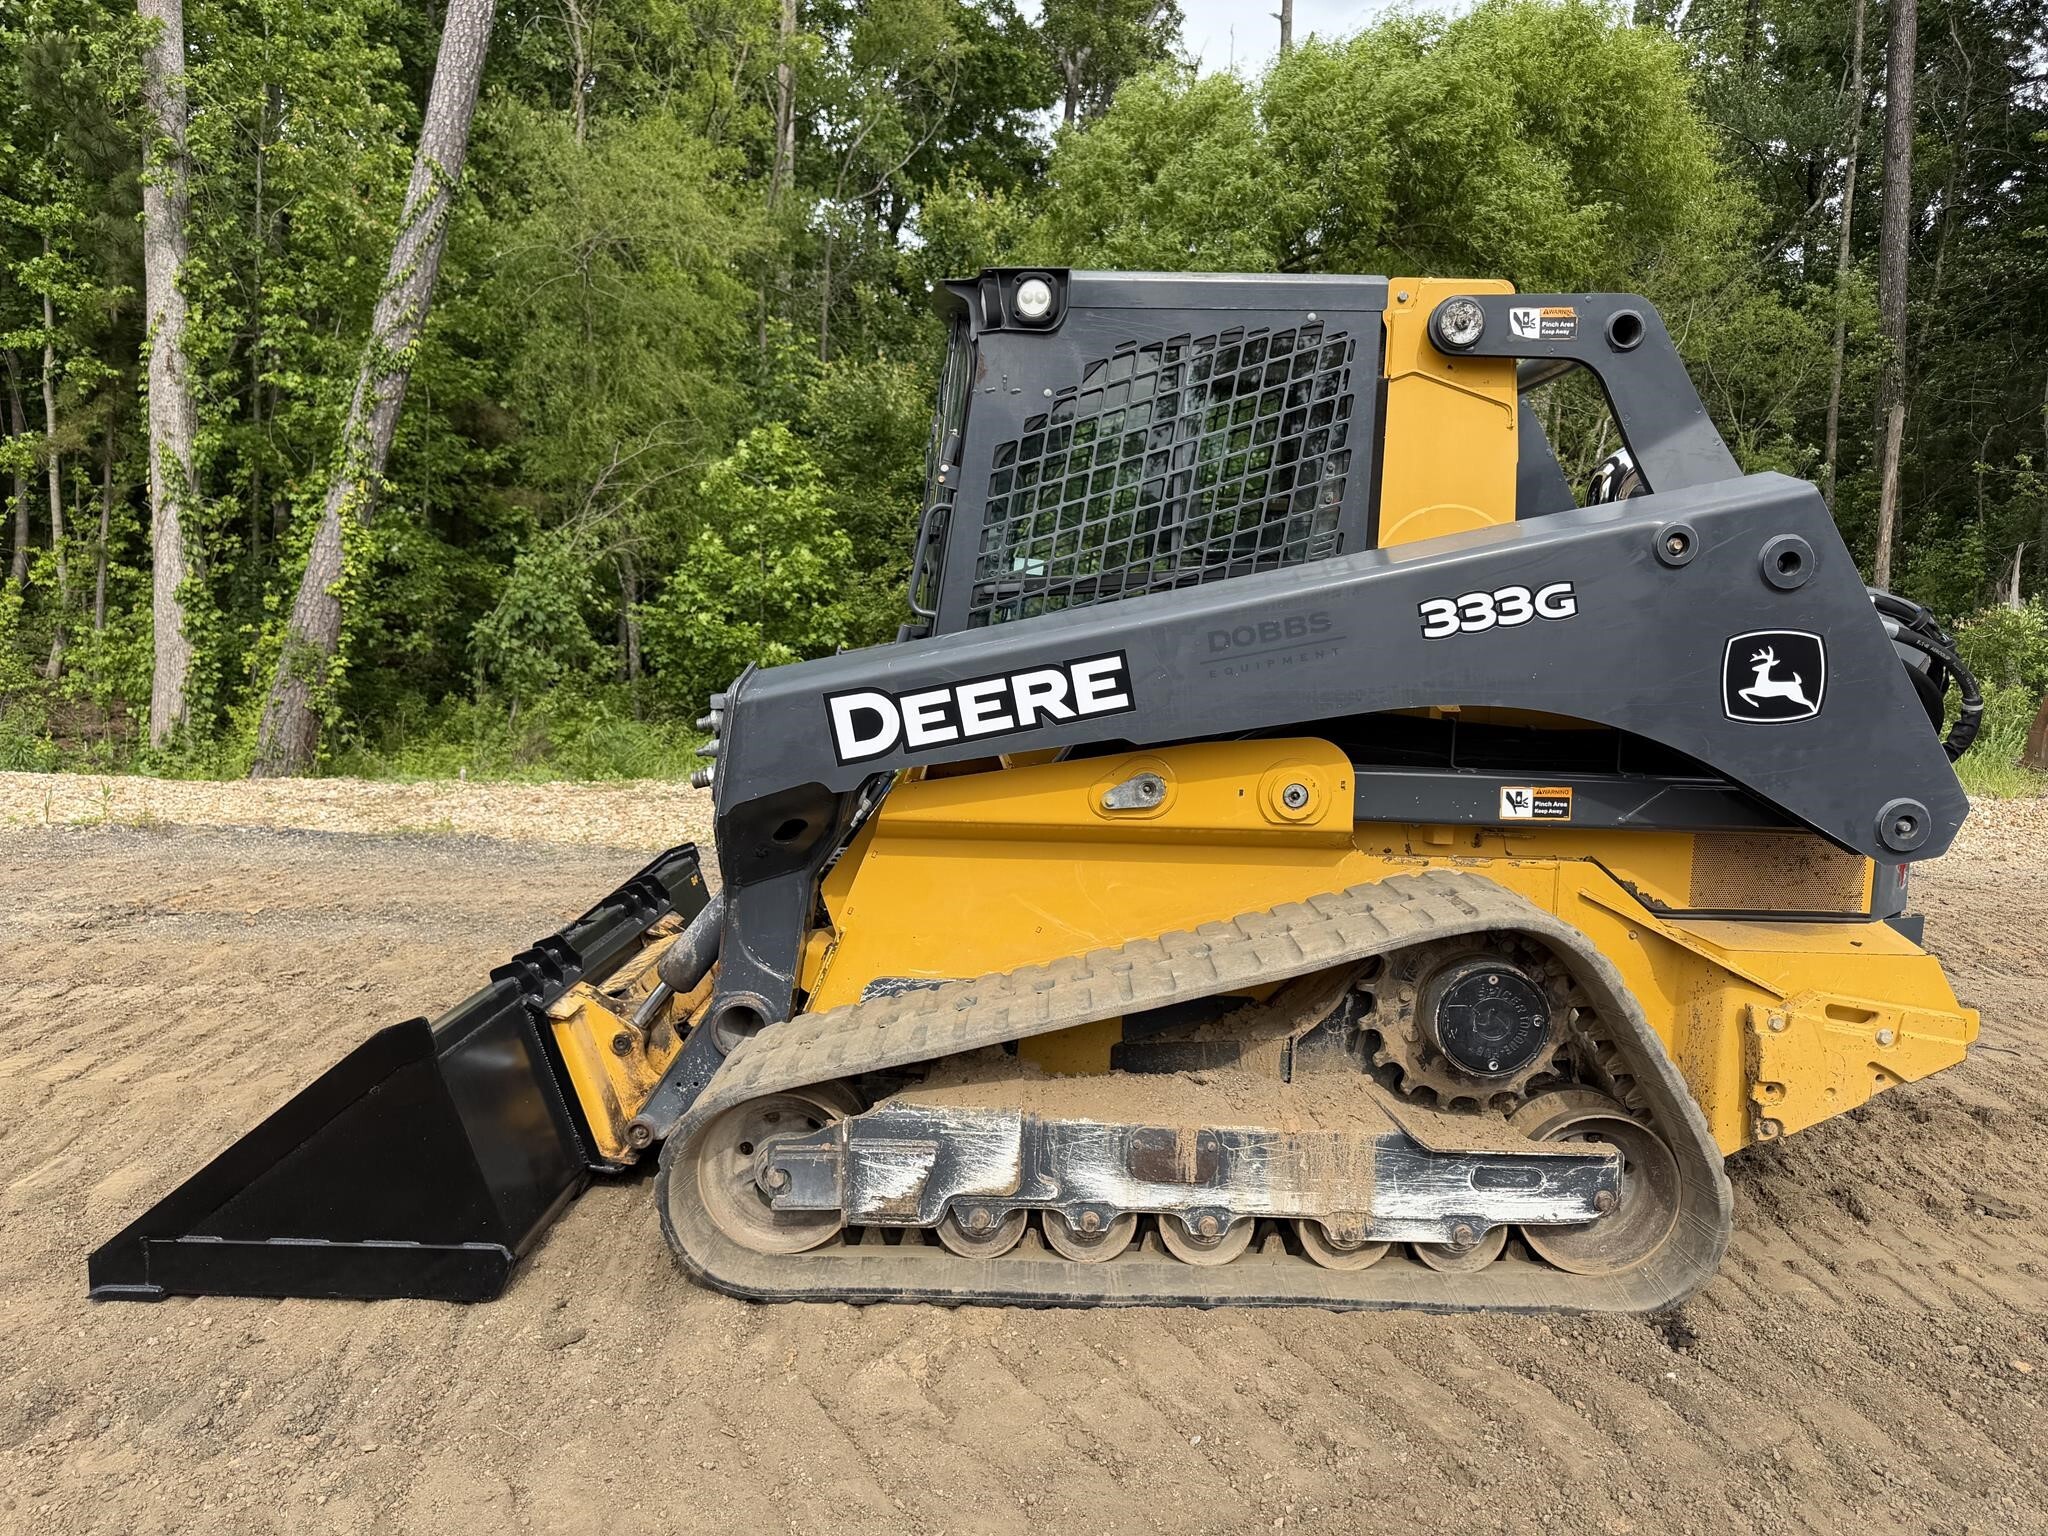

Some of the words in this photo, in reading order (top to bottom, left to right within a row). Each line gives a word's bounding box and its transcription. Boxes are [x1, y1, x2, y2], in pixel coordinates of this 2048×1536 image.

[1420, 582, 1577, 638] 333G
[1207, 611, 1333, 653] DOBBS
[1209, 647, 1340, 679] EQUIPMENT
[827, 654, 1131, 762] DEERE
[1477, 985, 1528, 1014] SPICER
